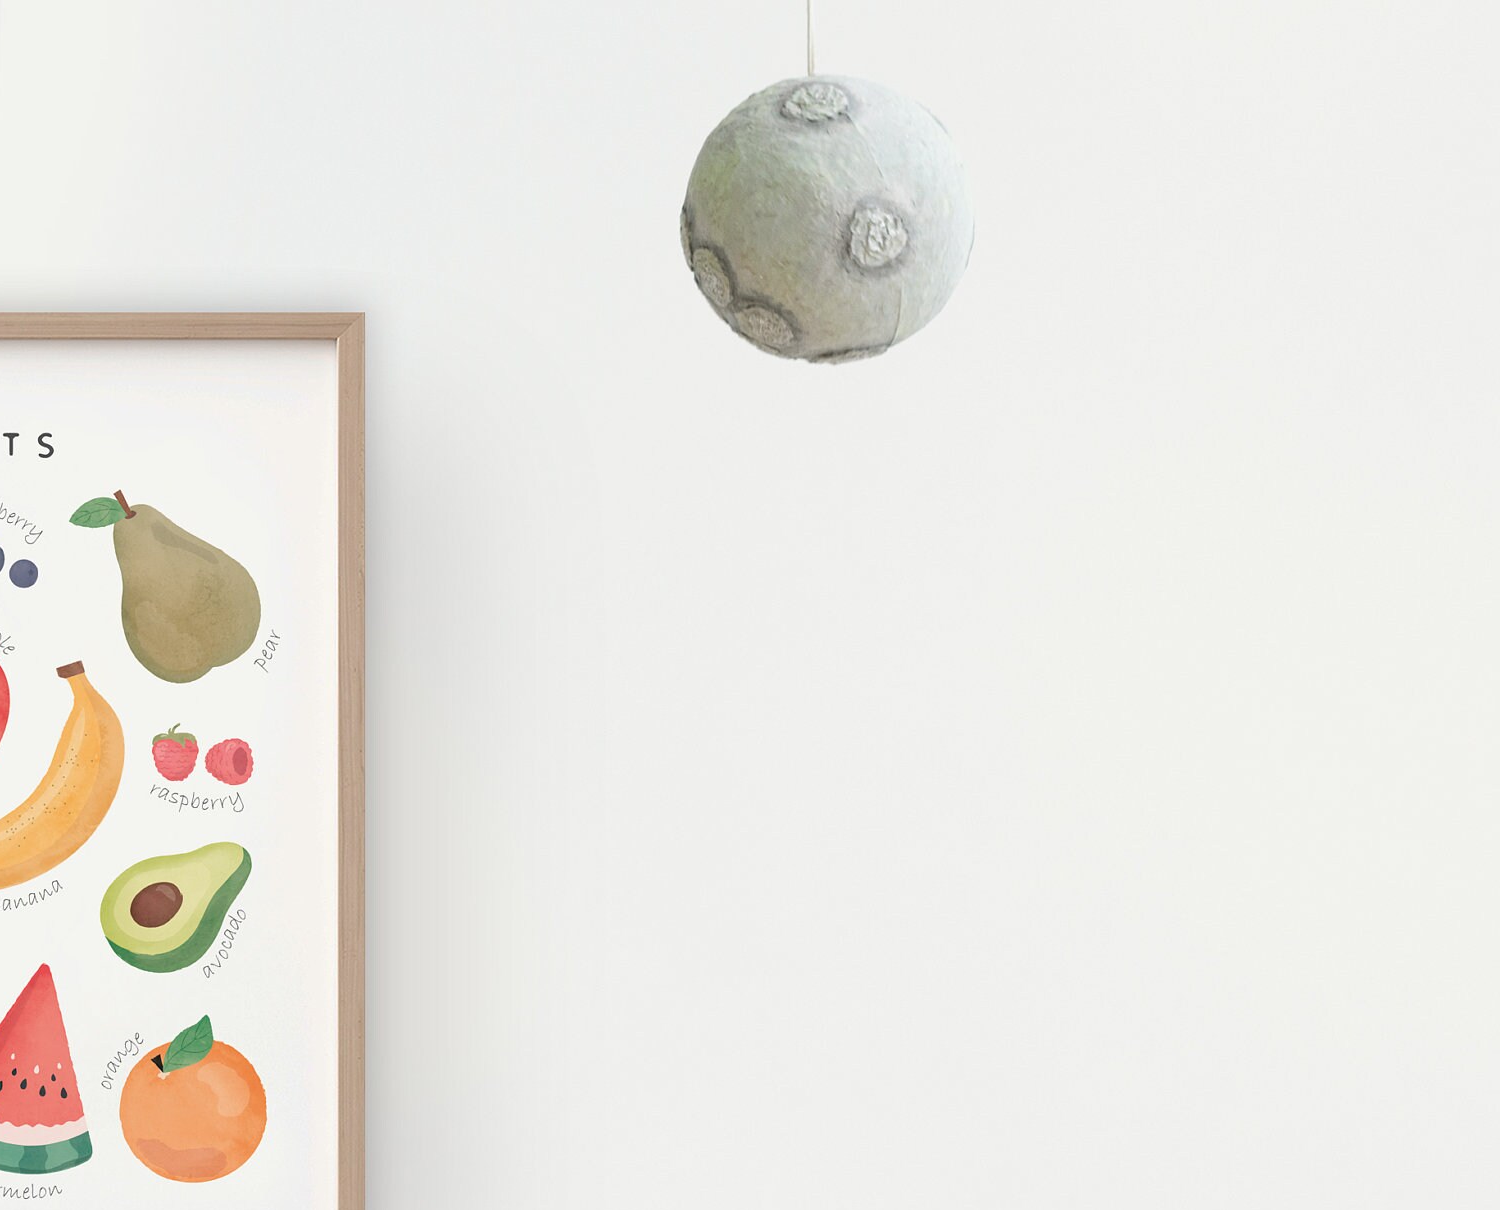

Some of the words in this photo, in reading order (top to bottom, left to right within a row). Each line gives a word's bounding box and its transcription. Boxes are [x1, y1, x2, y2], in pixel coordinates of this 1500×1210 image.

[253, 629, 282, 673] pear
[149, 783, 245, 813] raspberry
[202, 908, 247, 979] avocado
[100, 1030, 145, 1091] orange
